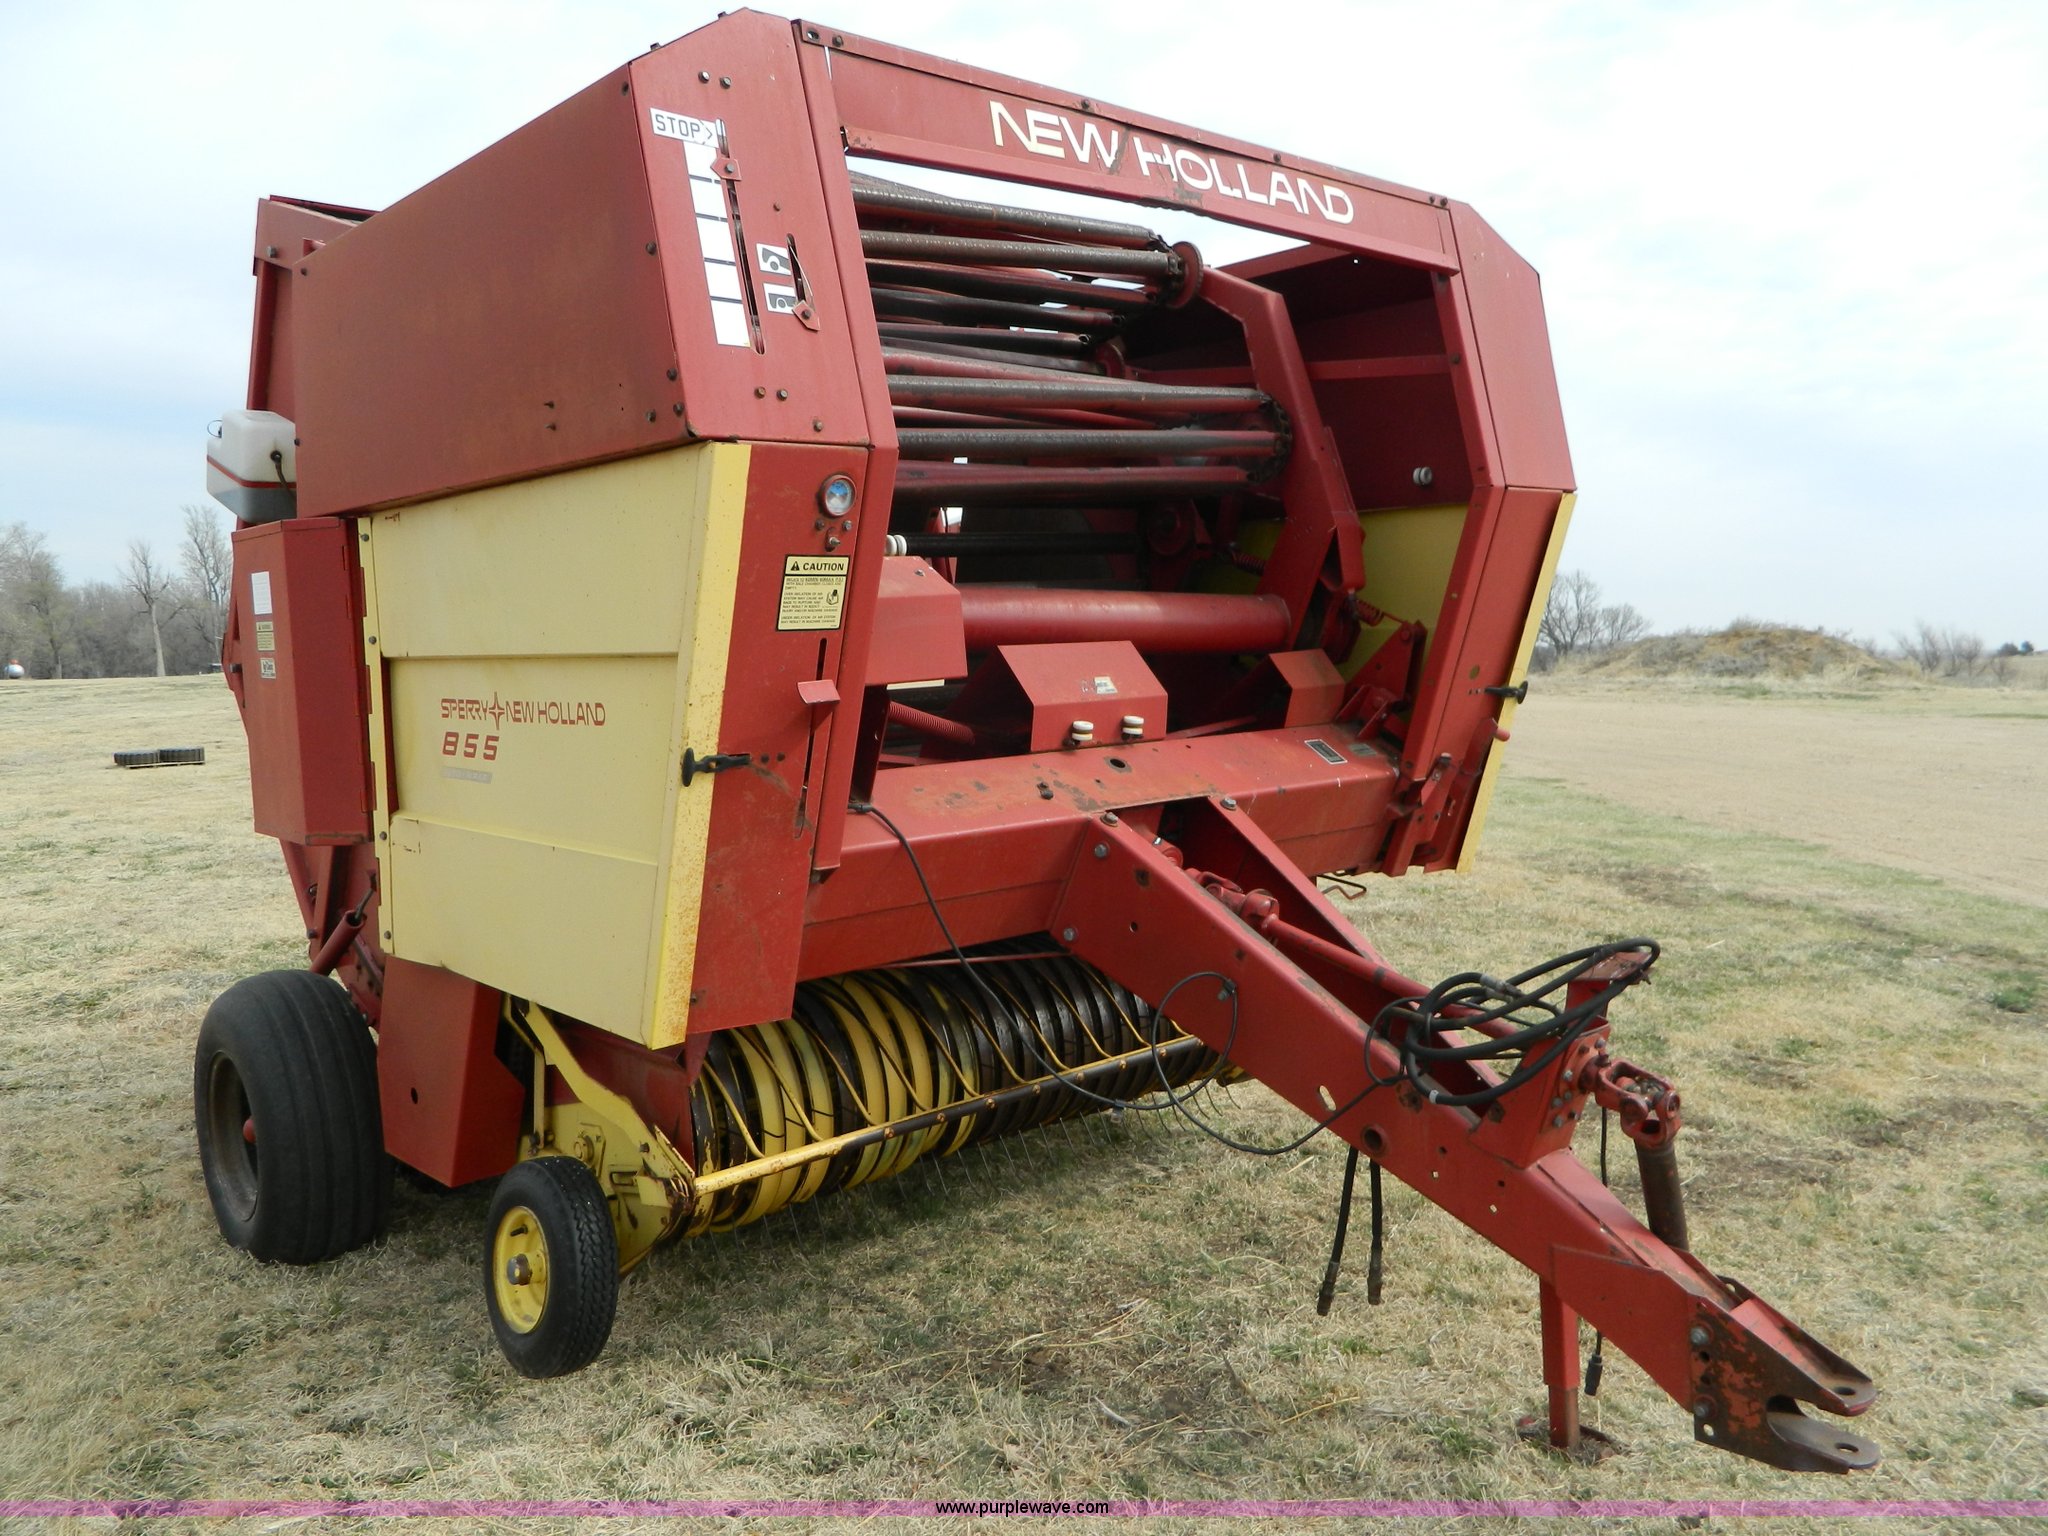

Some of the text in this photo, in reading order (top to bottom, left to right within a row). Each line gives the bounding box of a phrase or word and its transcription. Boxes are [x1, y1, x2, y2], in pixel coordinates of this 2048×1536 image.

[654, 114, 701, 138] STOP
[989, 100, 1354, 224] NEW HOLLAND
[803, 562, 845, 571] CAUTION
[440, 698, 606, 726] SPERRY NEW HOLLAND
[442, 731, 500, 761] 855
